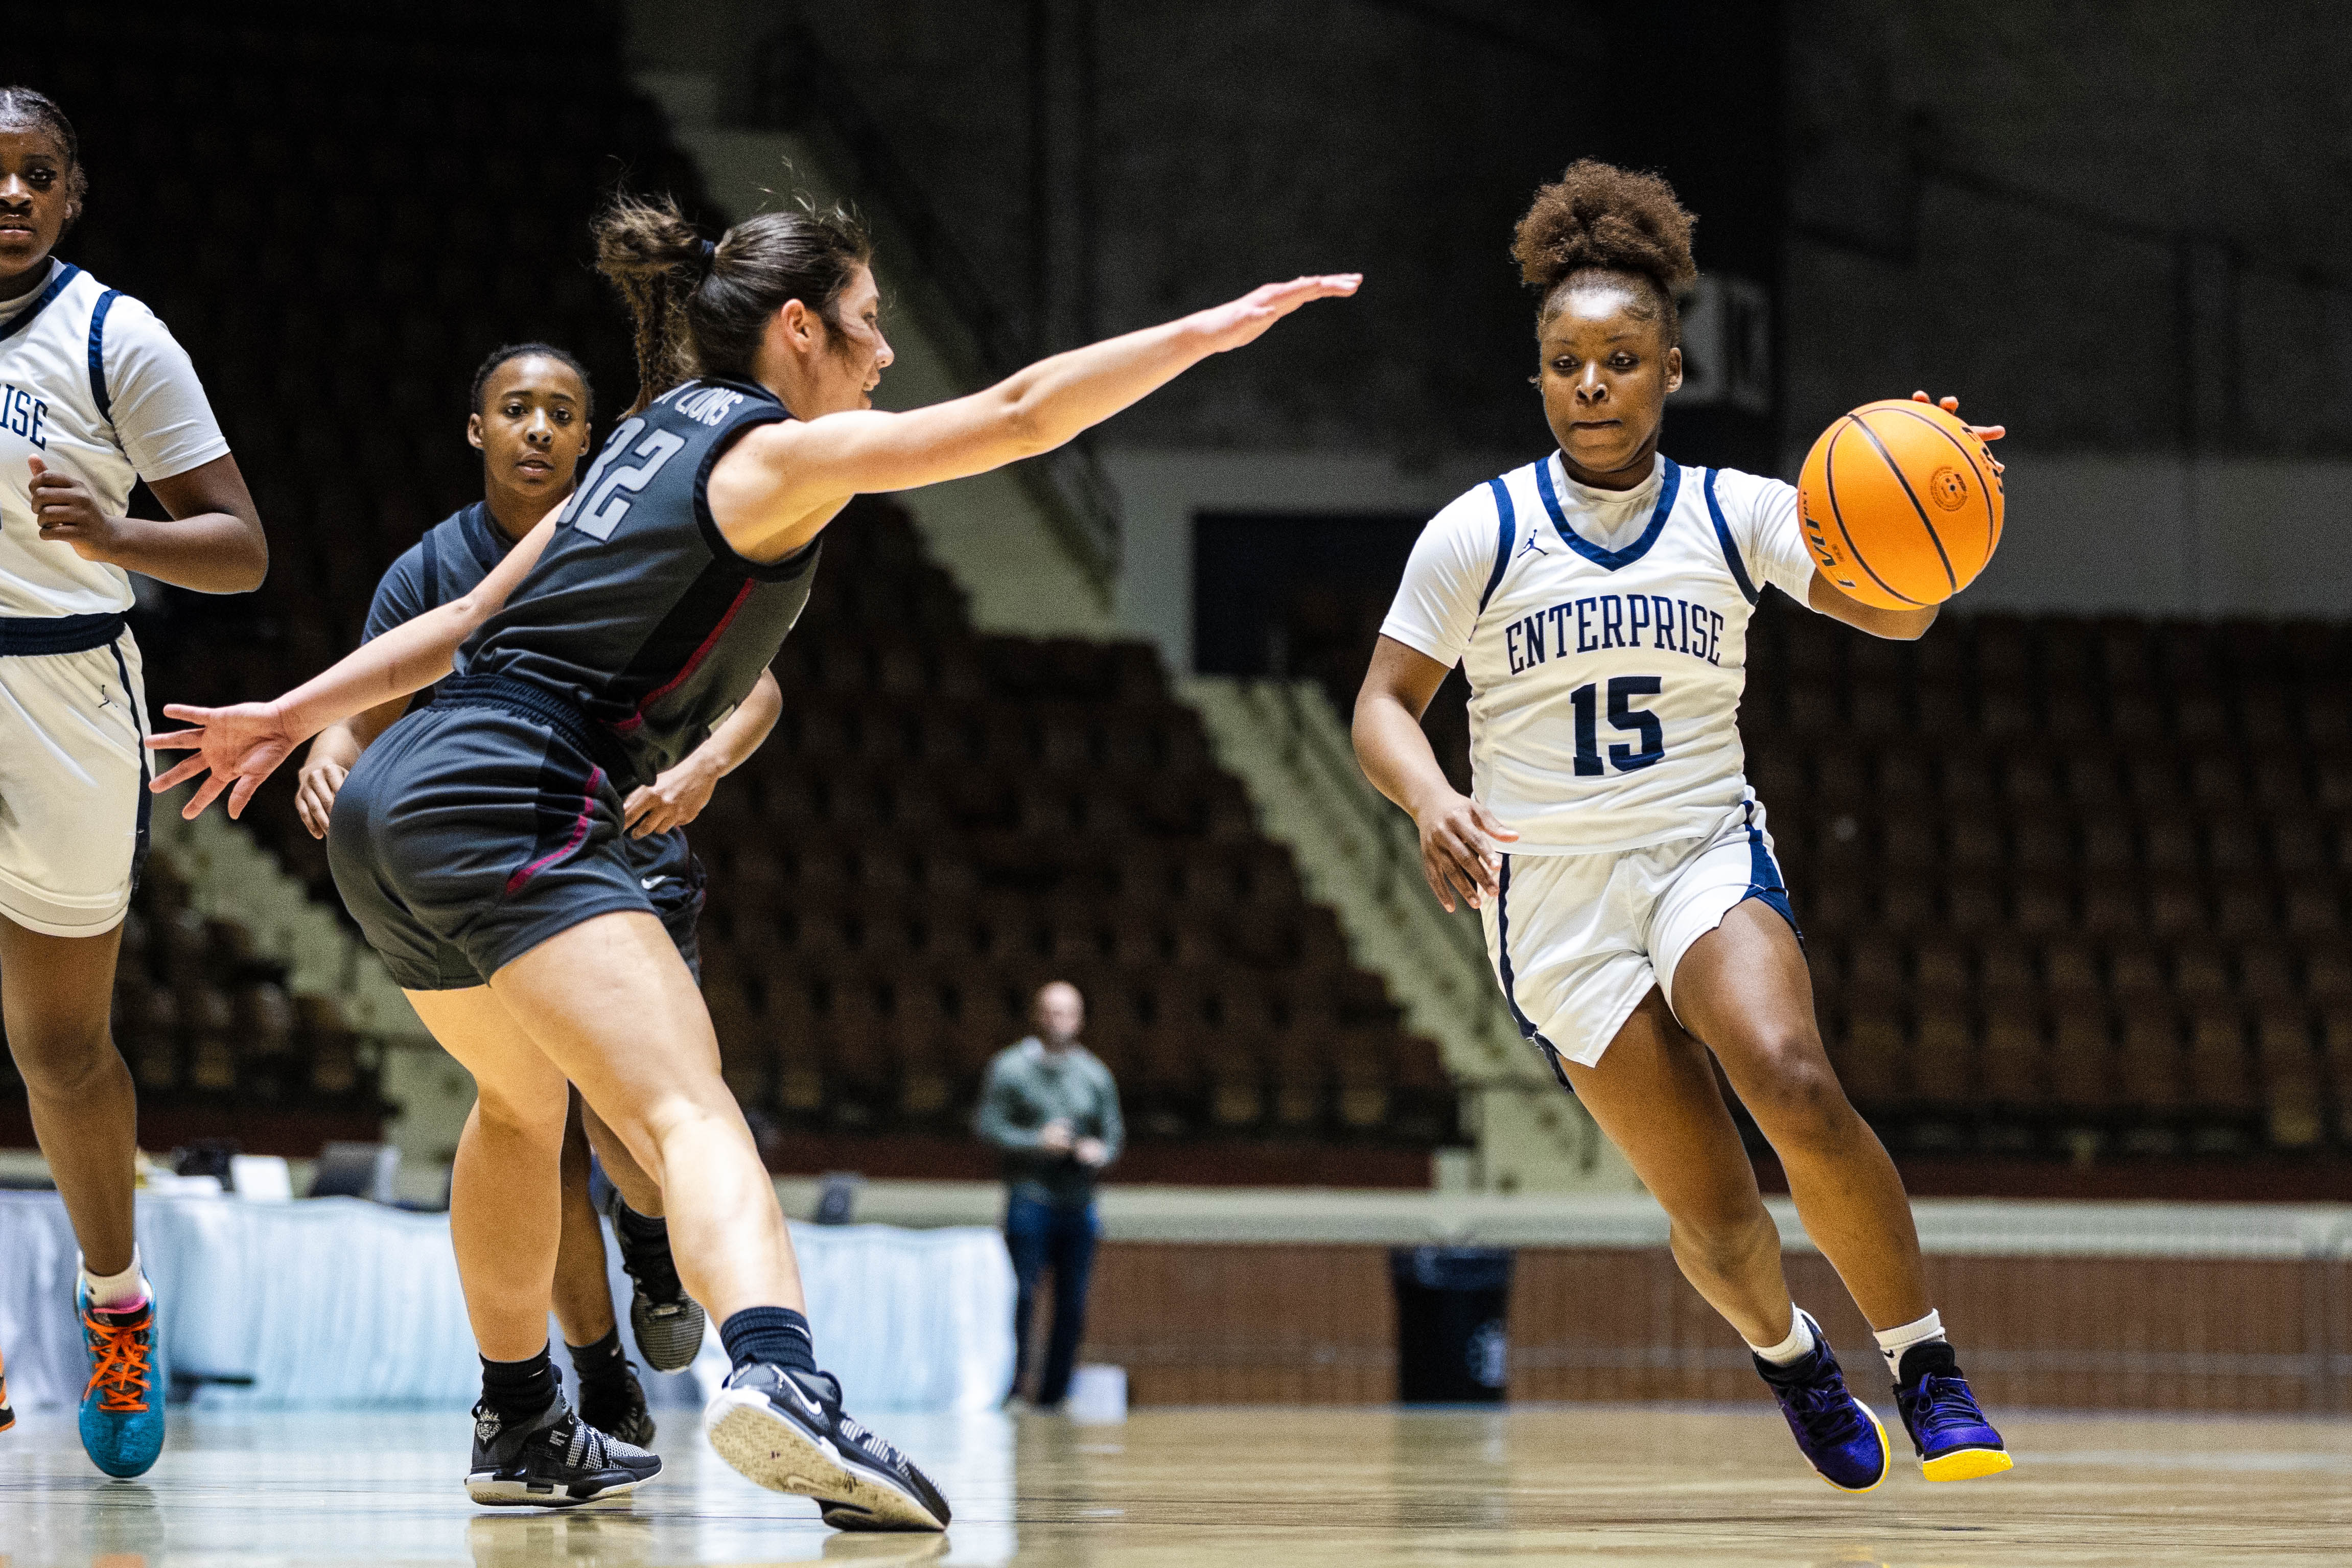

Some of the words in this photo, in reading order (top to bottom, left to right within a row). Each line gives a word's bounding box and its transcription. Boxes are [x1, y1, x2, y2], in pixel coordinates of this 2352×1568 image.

[0, 383, 49, 451] ISE
[1506, 594, 1724, 675] ENTERPRISE
[1571, 676, 1665, 776] 15
